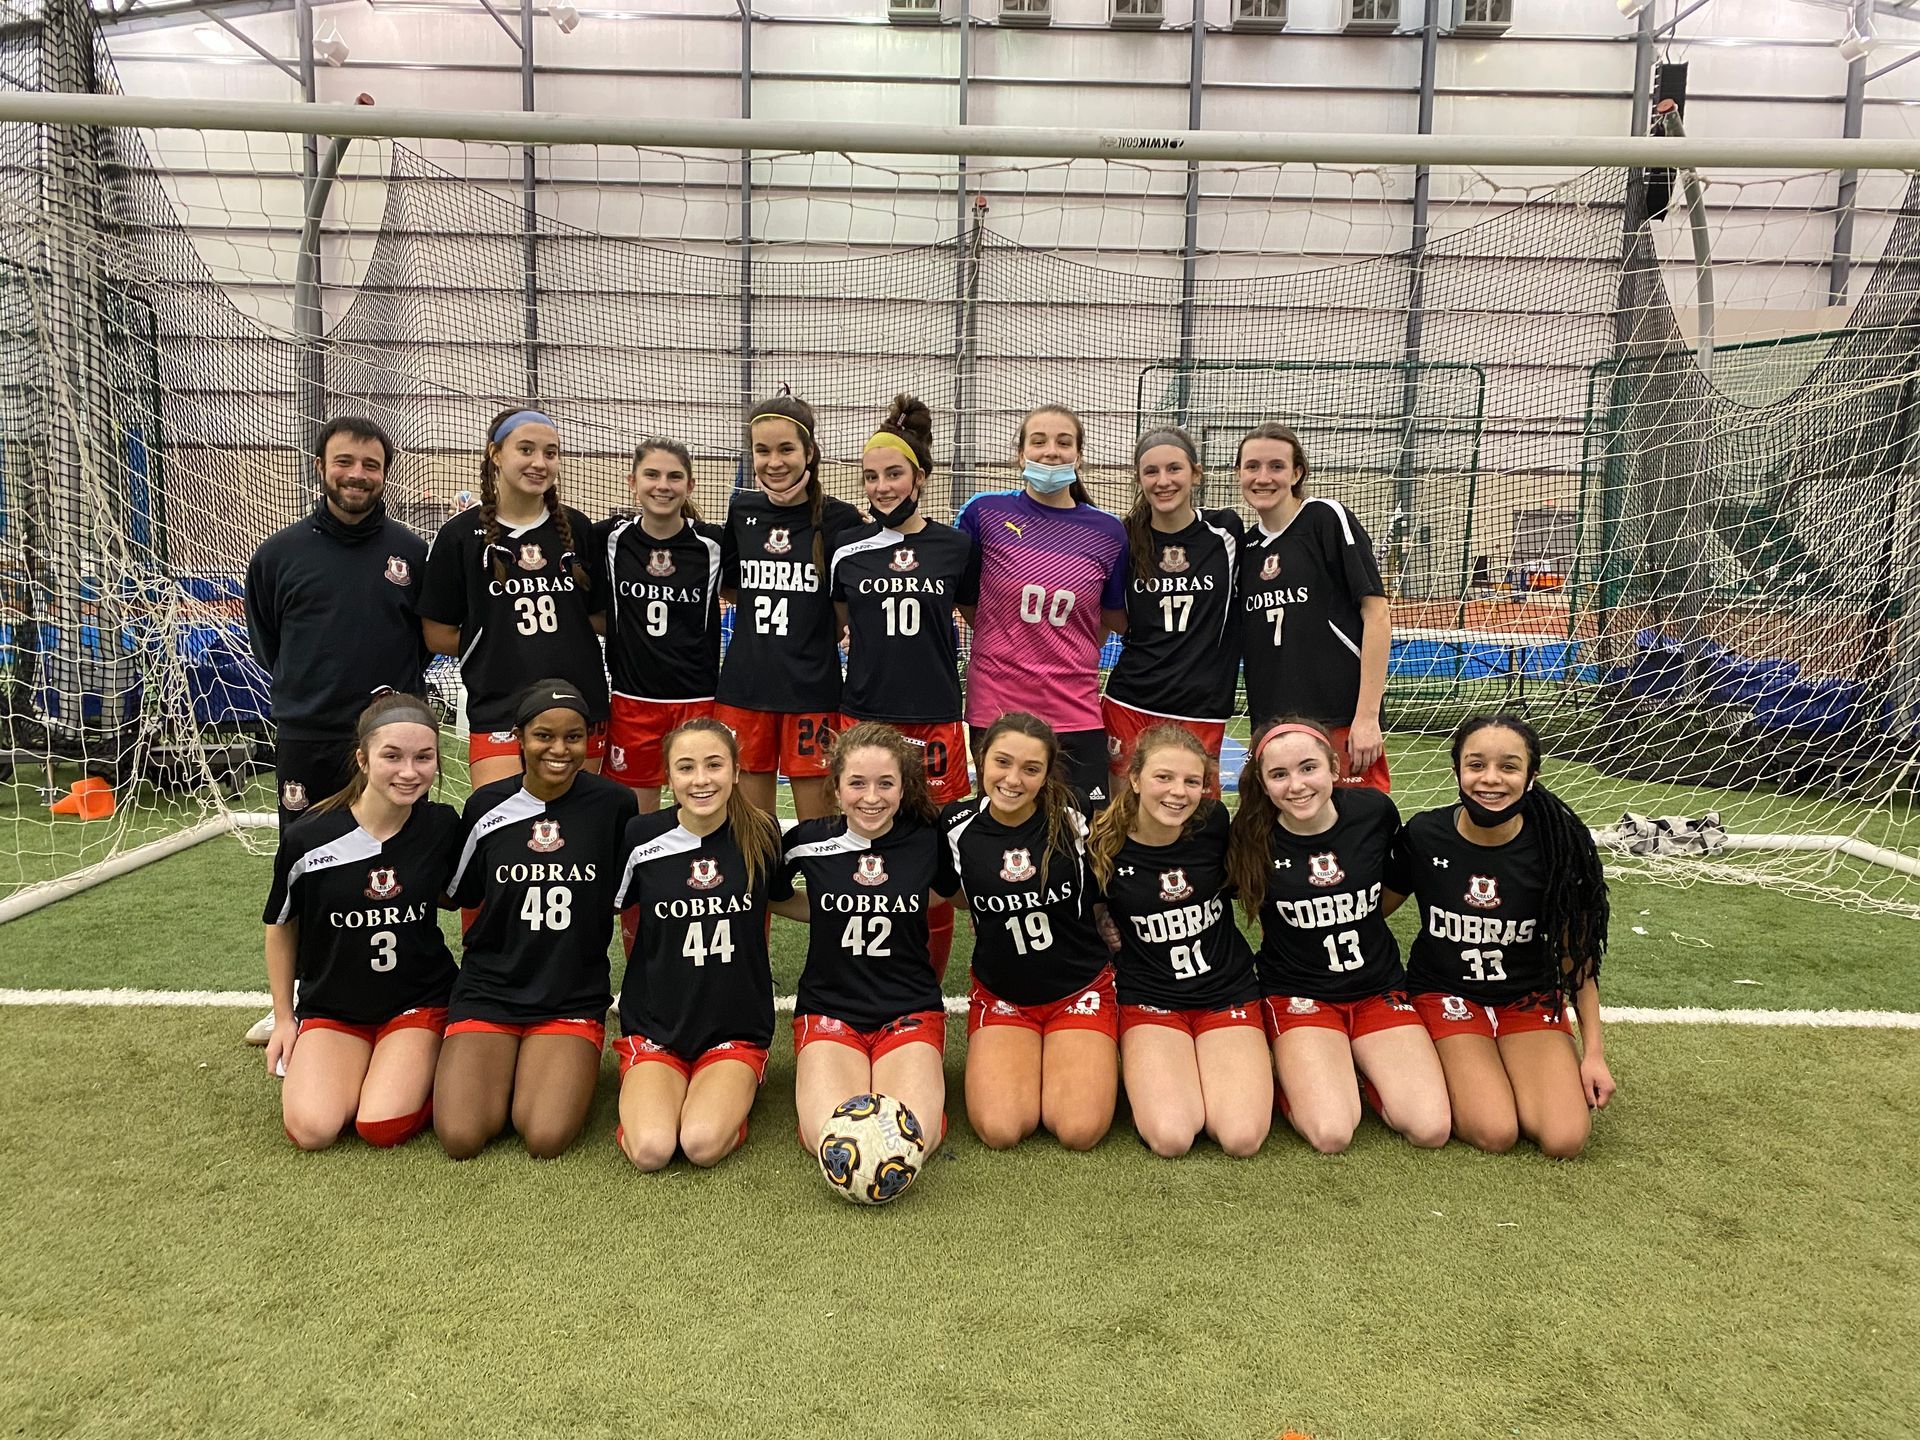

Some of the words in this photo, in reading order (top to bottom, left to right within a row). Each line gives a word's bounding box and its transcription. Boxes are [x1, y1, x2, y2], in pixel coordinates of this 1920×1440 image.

[488, 576, 575, 596] COBRAS
[619, 580, 701, 603] COBRAS
[739, 559, 819, 593] COBRAS
[858, 577, 945, 596] COBRAS
[1133, 574, 1214, 594] COBRAS
[514, 595, 558, 636] 38
[646, 600, 668, 637] 9
[754, 595, 789, 637] 24
[881, 596, 921, 637] 10
[1020, 583, 1076, 627] 00
[1159, 594, 1194, 632] 17
[1245, 586, 1309, 612] COBRAS
[1265, 607, 1285, 647] 7
[495, 863, 596, 884] COBRAS
[330, 902, 427, 928] COBRAS
[520, 885, 573, 931] 48
[654, 892, 752, 919] COBRAS
[820, 892, 919, 913] COBRAS
[973, 881, 1072, 912] COBRAS
[1276, 881, 1382, 929] COBRAS
[841, 915, 892, 957] 42
[1004, 911, 1054, 955] 19
[1130, 897, 1223, 944] COBRAS
[1429, 905, 1537, 946] COBRAS
[370, 930, 397, 972] 3
[682, 918, 735, 967] 44
[1169, 939, 1212, 980] 91
[1322, 929, 1365, 973] 13
[1460, 948, 1508, 981] 33
